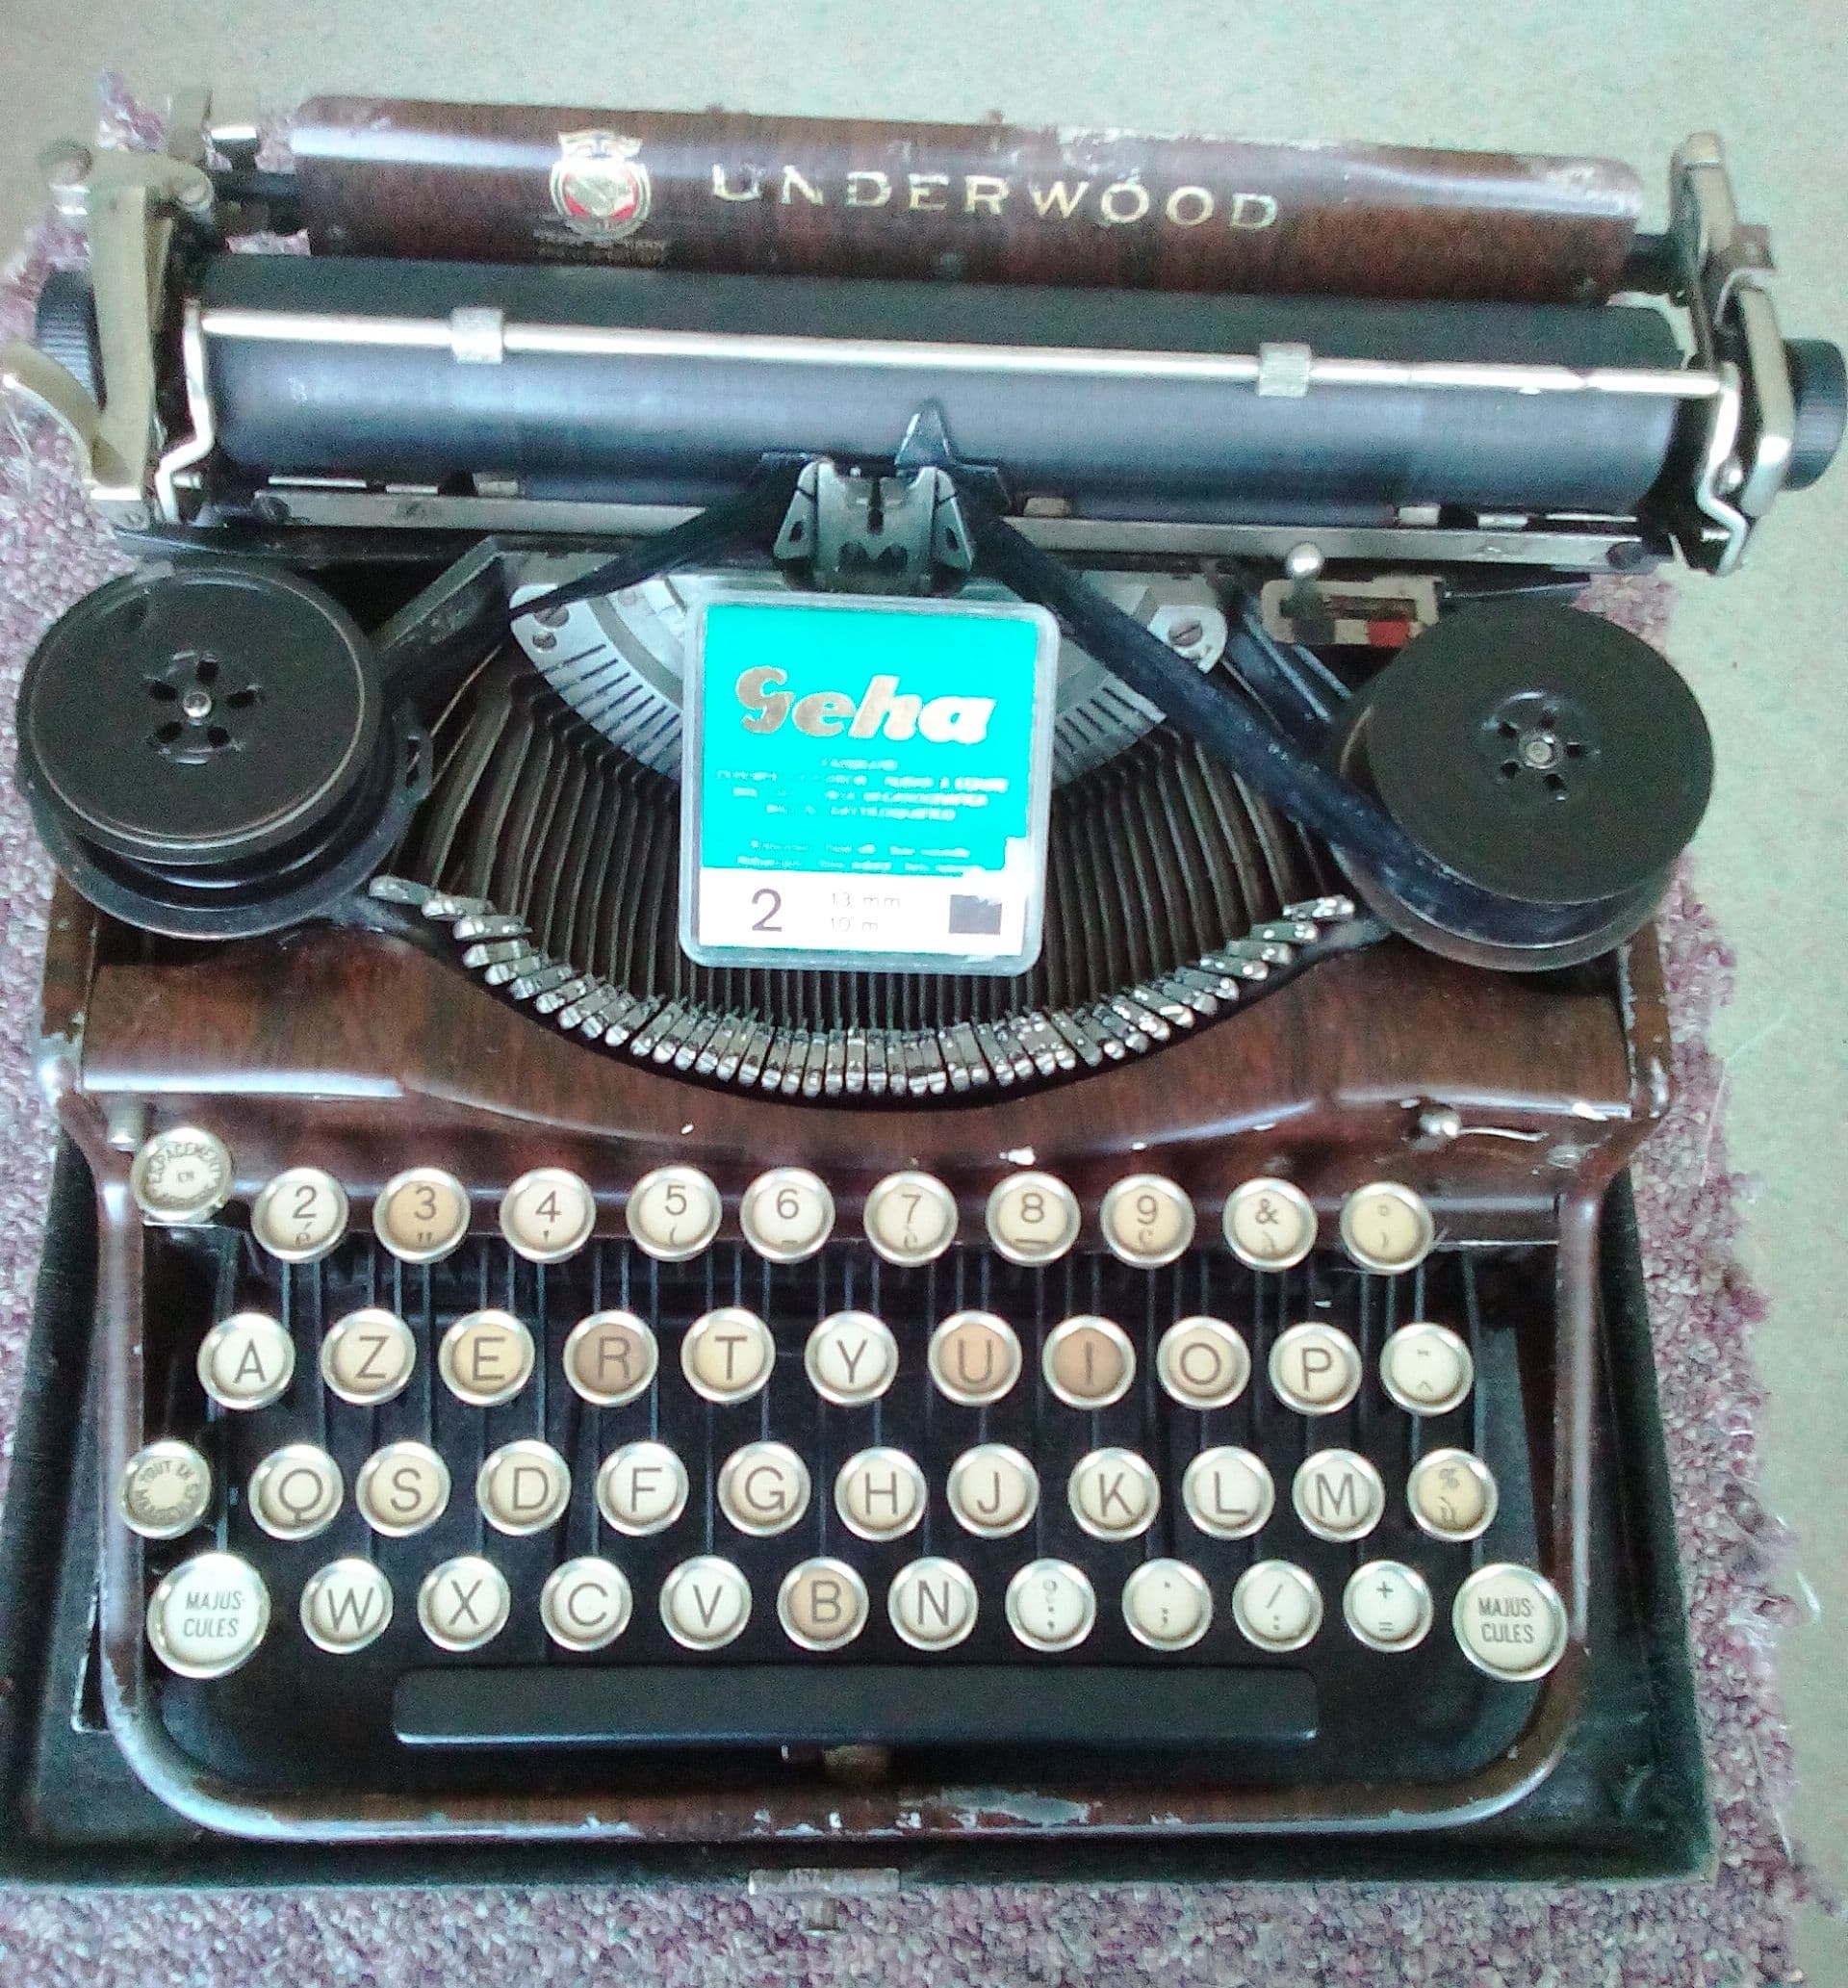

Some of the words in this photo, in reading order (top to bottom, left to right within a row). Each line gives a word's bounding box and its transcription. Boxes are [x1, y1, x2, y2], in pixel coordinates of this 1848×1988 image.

[709, 163, 1279, 229] UNDERWOOD
[735, 665, 997, 744] Geha
[751, 888, 783, 932] 2
[862, 895, 901, 910] mm
[292, 1185, 317, 1220] 2
[414, 1186, 436, 1220] 3
[535, 1191, 562, 1223] 4
[665, 1185, 688, 1216] 5
[776, 1188, 800, 1219] 6
[901, 1194, 922, 1225] 7
[1021, 1192, 1045, 1224] 8
[1137, 1195, 1157, 1225] 9
[1255, 1198, 1280, 1225] &
[233, 1338, 268, 1384] A
[354, 1334, 390, 1380] Z
[472, 1336, 506, 1381] E
[597, 1336, 630, 1381] R
[714, 1335, 748, 1381] T
[836, 1339, 869, 1383] Y
[957, 1339, 992, 1383] U
[1180, 1342, 1221, 1385] O
[1301, 1347, 1333, 1393] P
[278, 1468, 323, 1525] Q
[389, 1467, 423, 1511] S
[511, 1467, 550, 1511] D
[631, 1467, 663, 1512] F
[744, 1466, 787, 1512] G
[864, 1471, 899, 1516] H
[976, 1471, 1001, 1514] J
[1098, 1472, 1134, 1517] K
[1214, 1470, 1248, 1514] L
[1316, 1472, 1358, 1518] M
[327, 1587, 376, 1632] W
[448, 1579, 484, 1627] X
[567, 1583, 609, 1627] C
[692, 1584, 724, 1628] V
[810, 1580, 843, 1624] B
[916, 1579, 951, 1626] N
[183, 1617, 240, 1638] CULES
[1480, 1622, 1536, 1645] CULES
